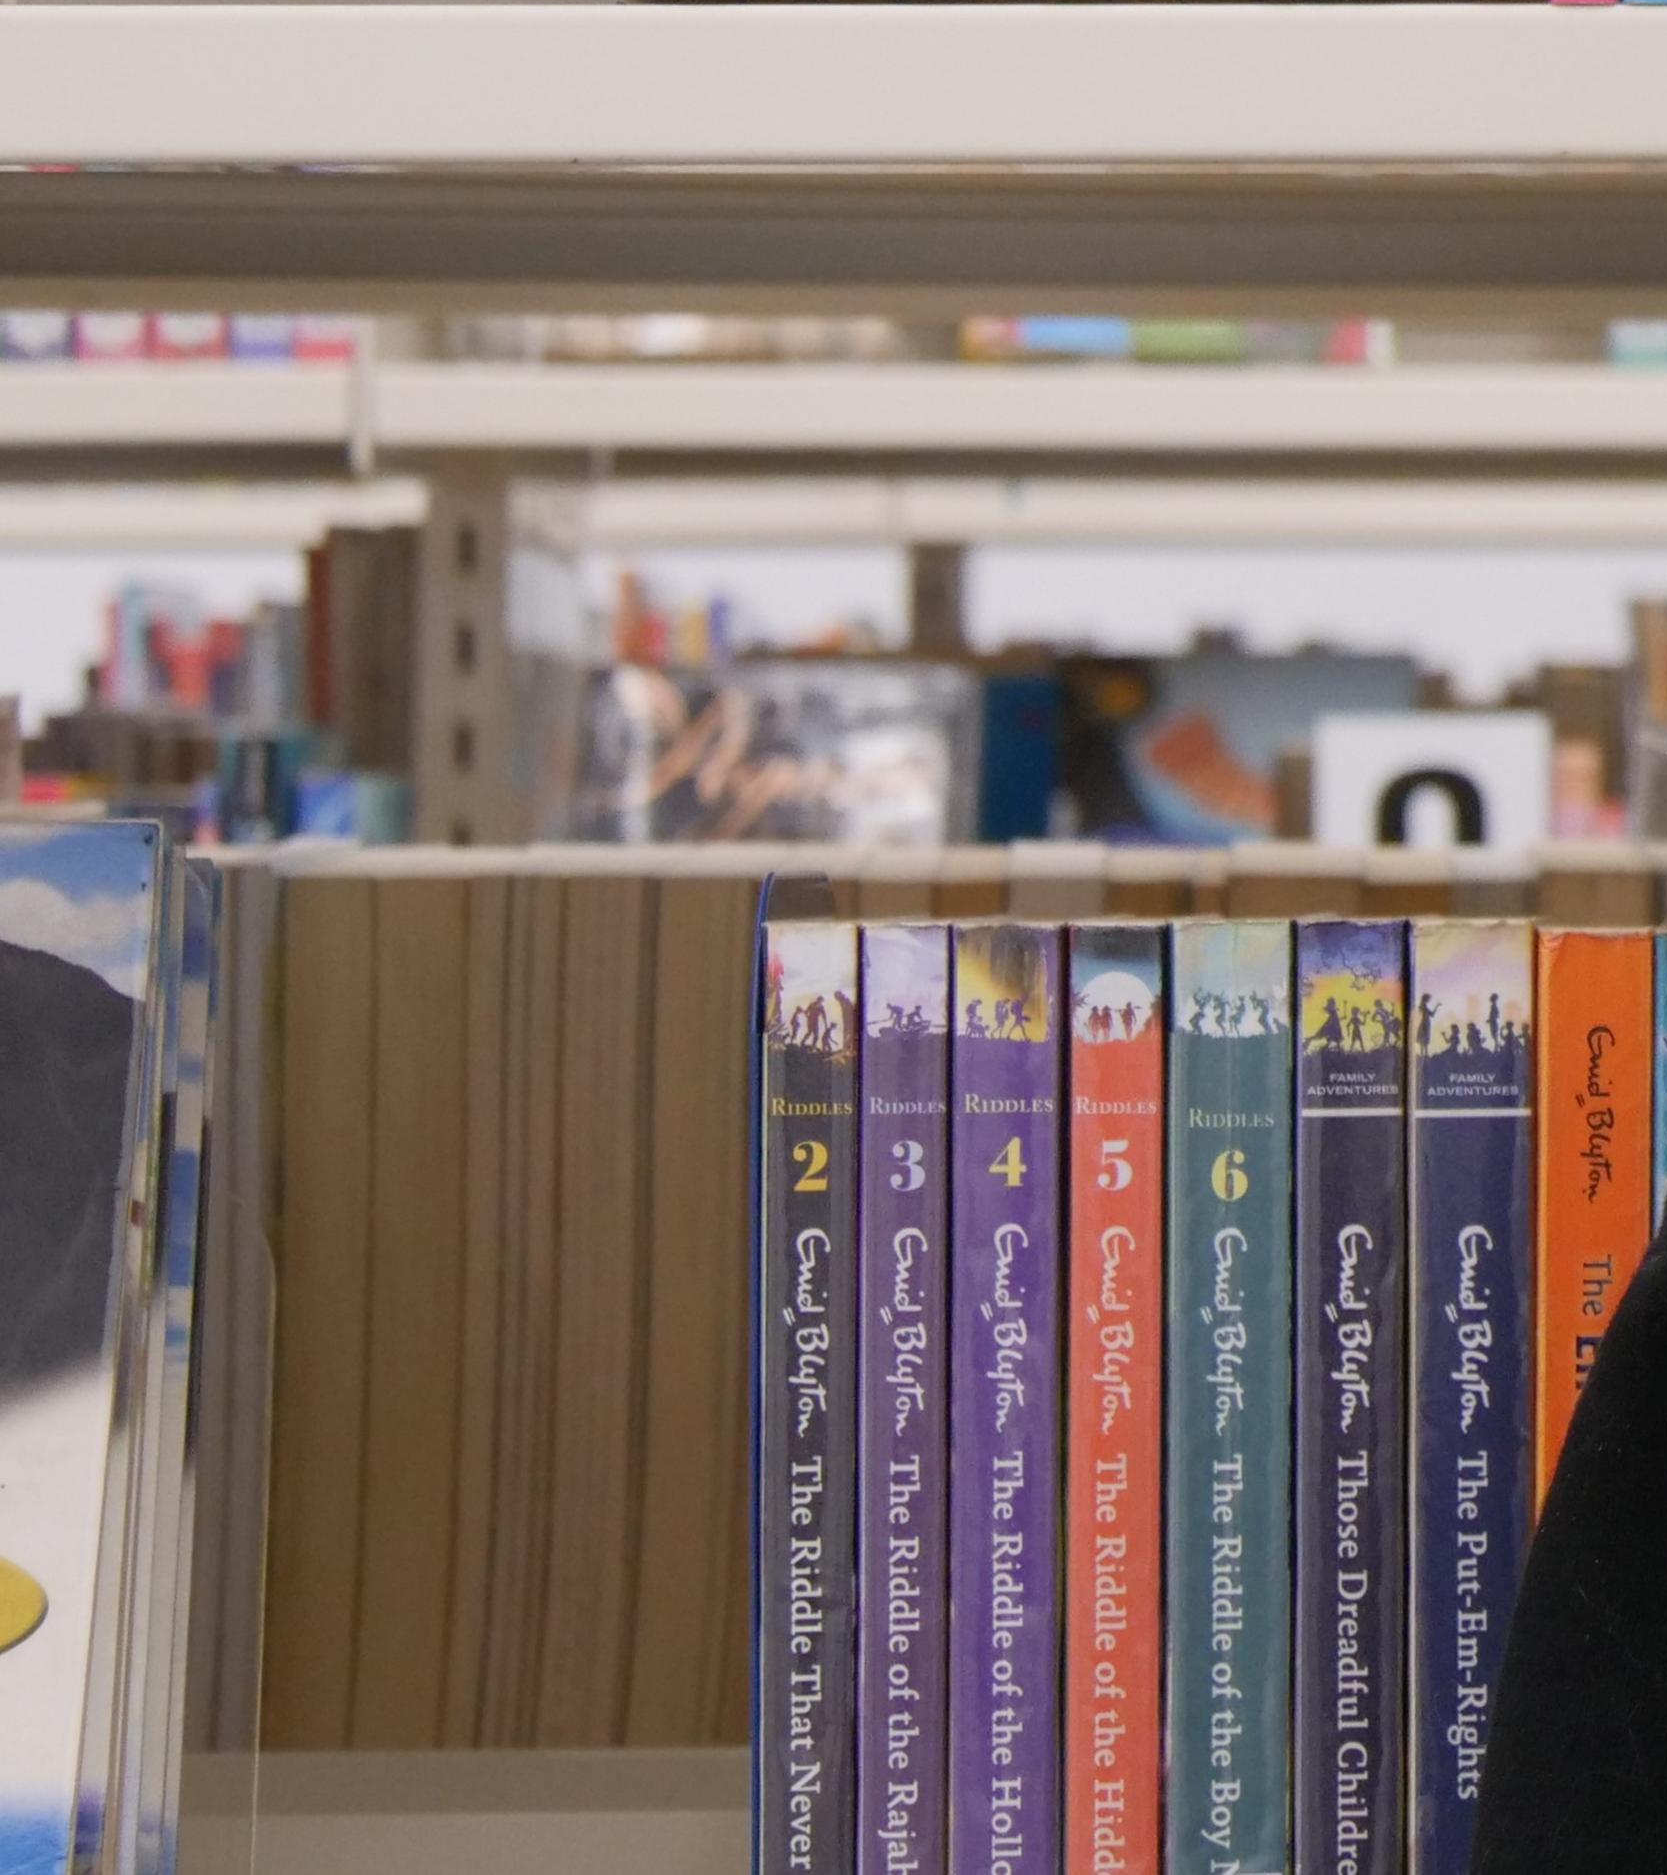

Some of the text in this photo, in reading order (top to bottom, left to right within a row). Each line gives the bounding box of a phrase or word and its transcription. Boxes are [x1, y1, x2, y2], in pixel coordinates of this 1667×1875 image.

[964, 1093, 1054, 1115] RIDDLES
[1427, 1085, 1519, 1097] ADVENTURES
[1449, 1073, 1497, 1084] FAMILY
[770, 1096, 853, 1116] RIDDLES
[868, 1095, 947, 1116] RIDDLES
[1075, 1095, 1158, 1116] RIDDLES
[1187, 1108, 1275, 1129] RIDDLES
[793, 1140, 829, 1192] 2
[889, 1139, 926, 1192] 3
[988, 1136, 1027, 1188] 4
[1097, 1139, 1133, 1192] 5
[1210, 1149, 1249, 1202] 6
[788, 1227, 832, 1438] Enid Blyton
[889, 1455, 920, 1525] The
[1337, 1450, 1369, 1560] Those
[888, 1535, 920, 1655] Riddle
[1337, 1569, 1369, 1732] Dreadful
[1446, 1450, 1489, 1801] The Put-Em-Rights
[789, 1456, 823, 1870] The Riddle That Never
[888, 1664, 920, 1701] of
[888, 1711, 919, 1771] the
